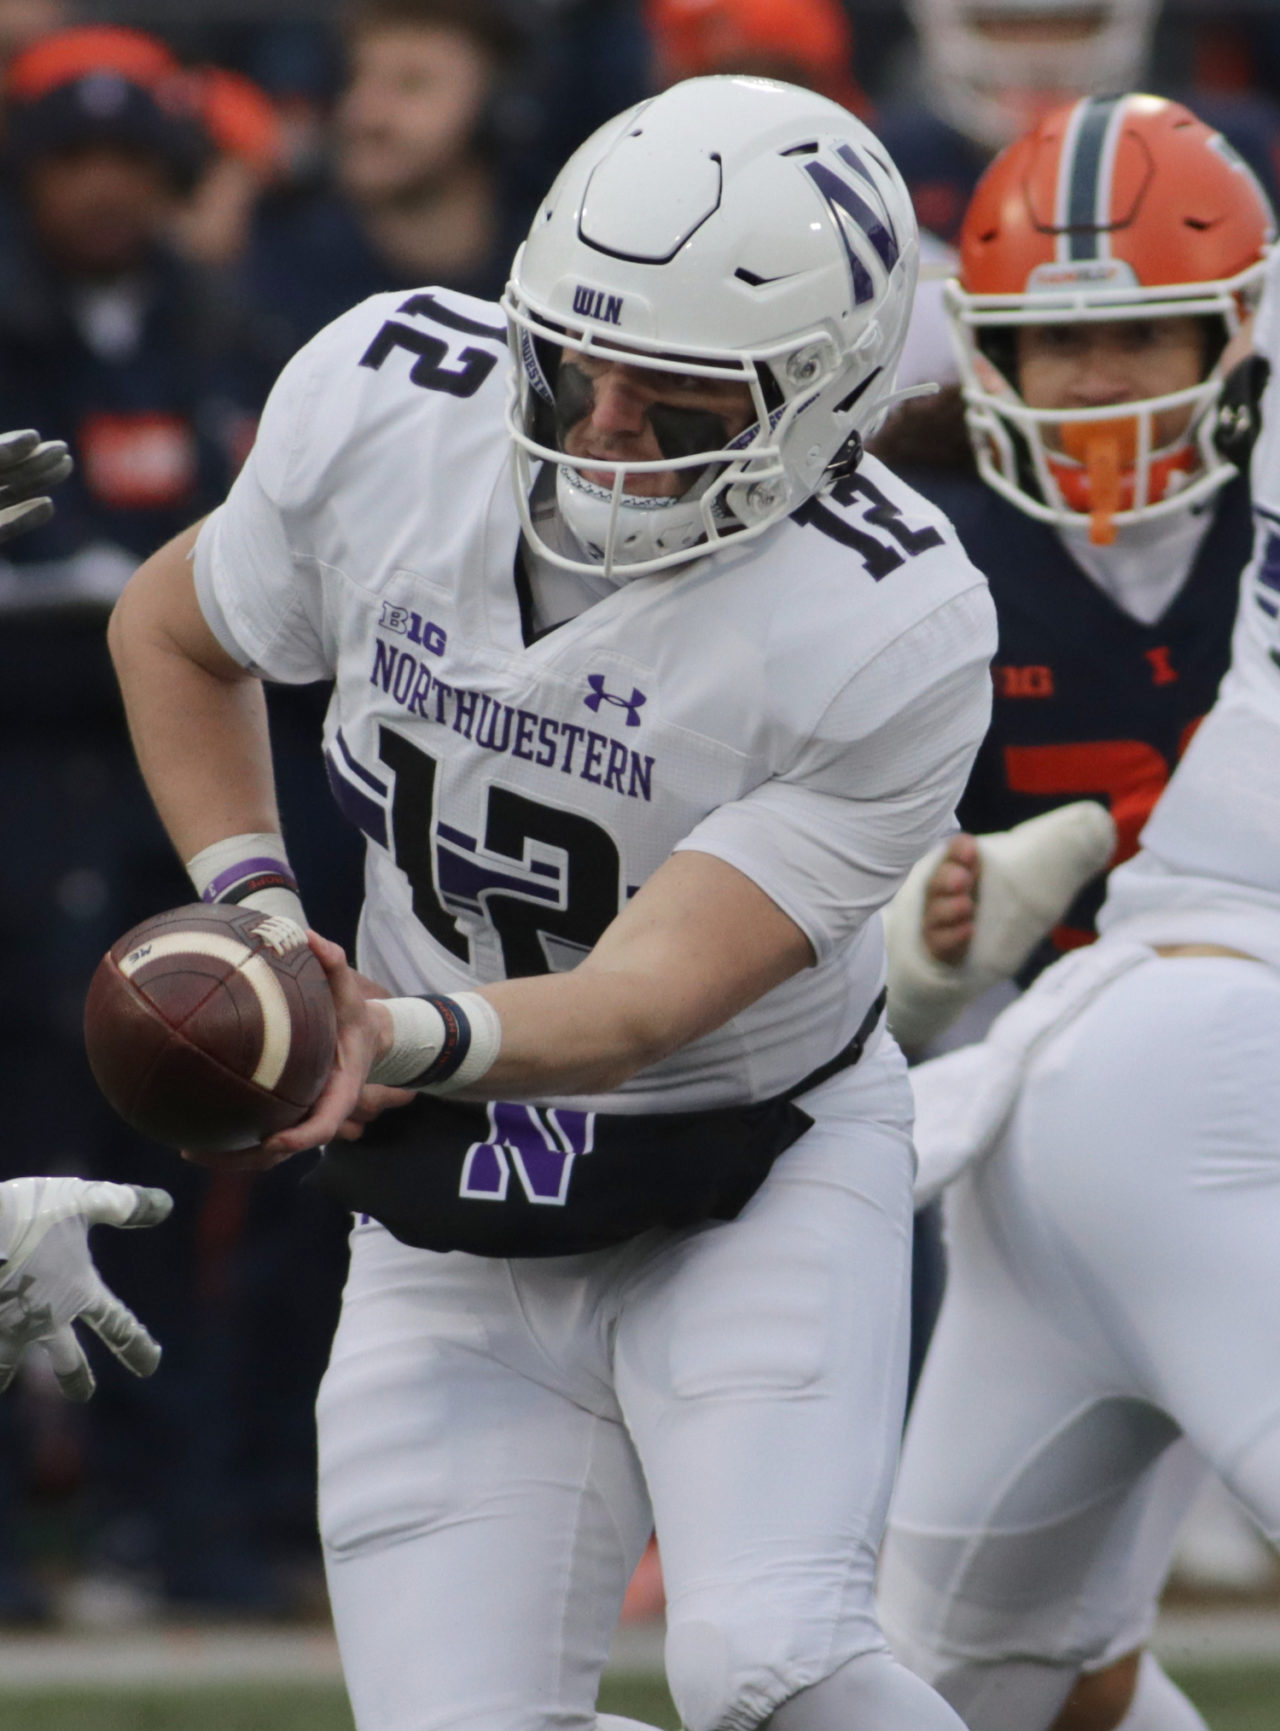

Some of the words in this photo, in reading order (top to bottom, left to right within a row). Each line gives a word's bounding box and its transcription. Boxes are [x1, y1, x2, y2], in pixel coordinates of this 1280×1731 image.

[358, 293, 509, 399] 12
[788, 472, 946, 583] 12
[370, 638, 655, 801] NORTHWESTERN
[378, 722, 620, 979] 12
[459, 1100, 596, 1206] N
